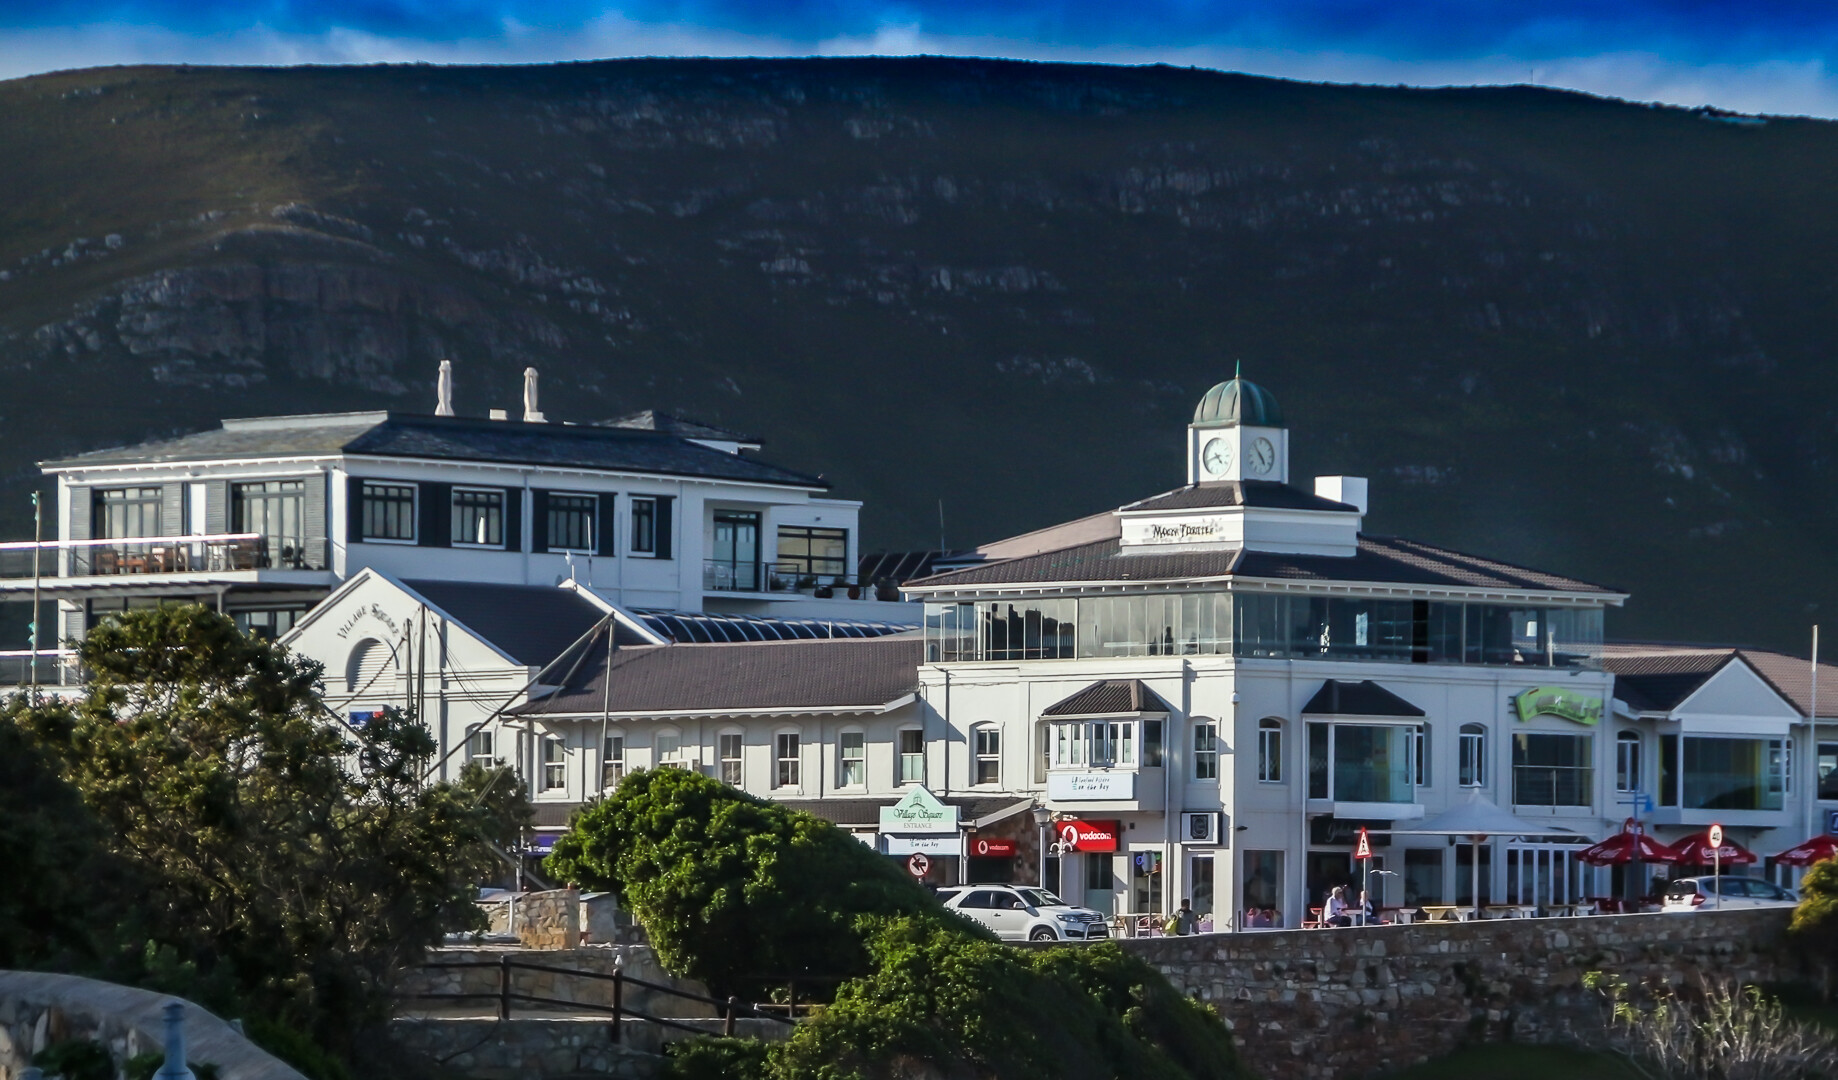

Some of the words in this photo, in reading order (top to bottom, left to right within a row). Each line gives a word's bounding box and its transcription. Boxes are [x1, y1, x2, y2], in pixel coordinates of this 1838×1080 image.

[894, 809, 916, 822] Village
[918, 809, 943, 822] Square
[1079, 831, 1112, 840] vodacom
[1701, 846, 1738, 859] CocaCola
